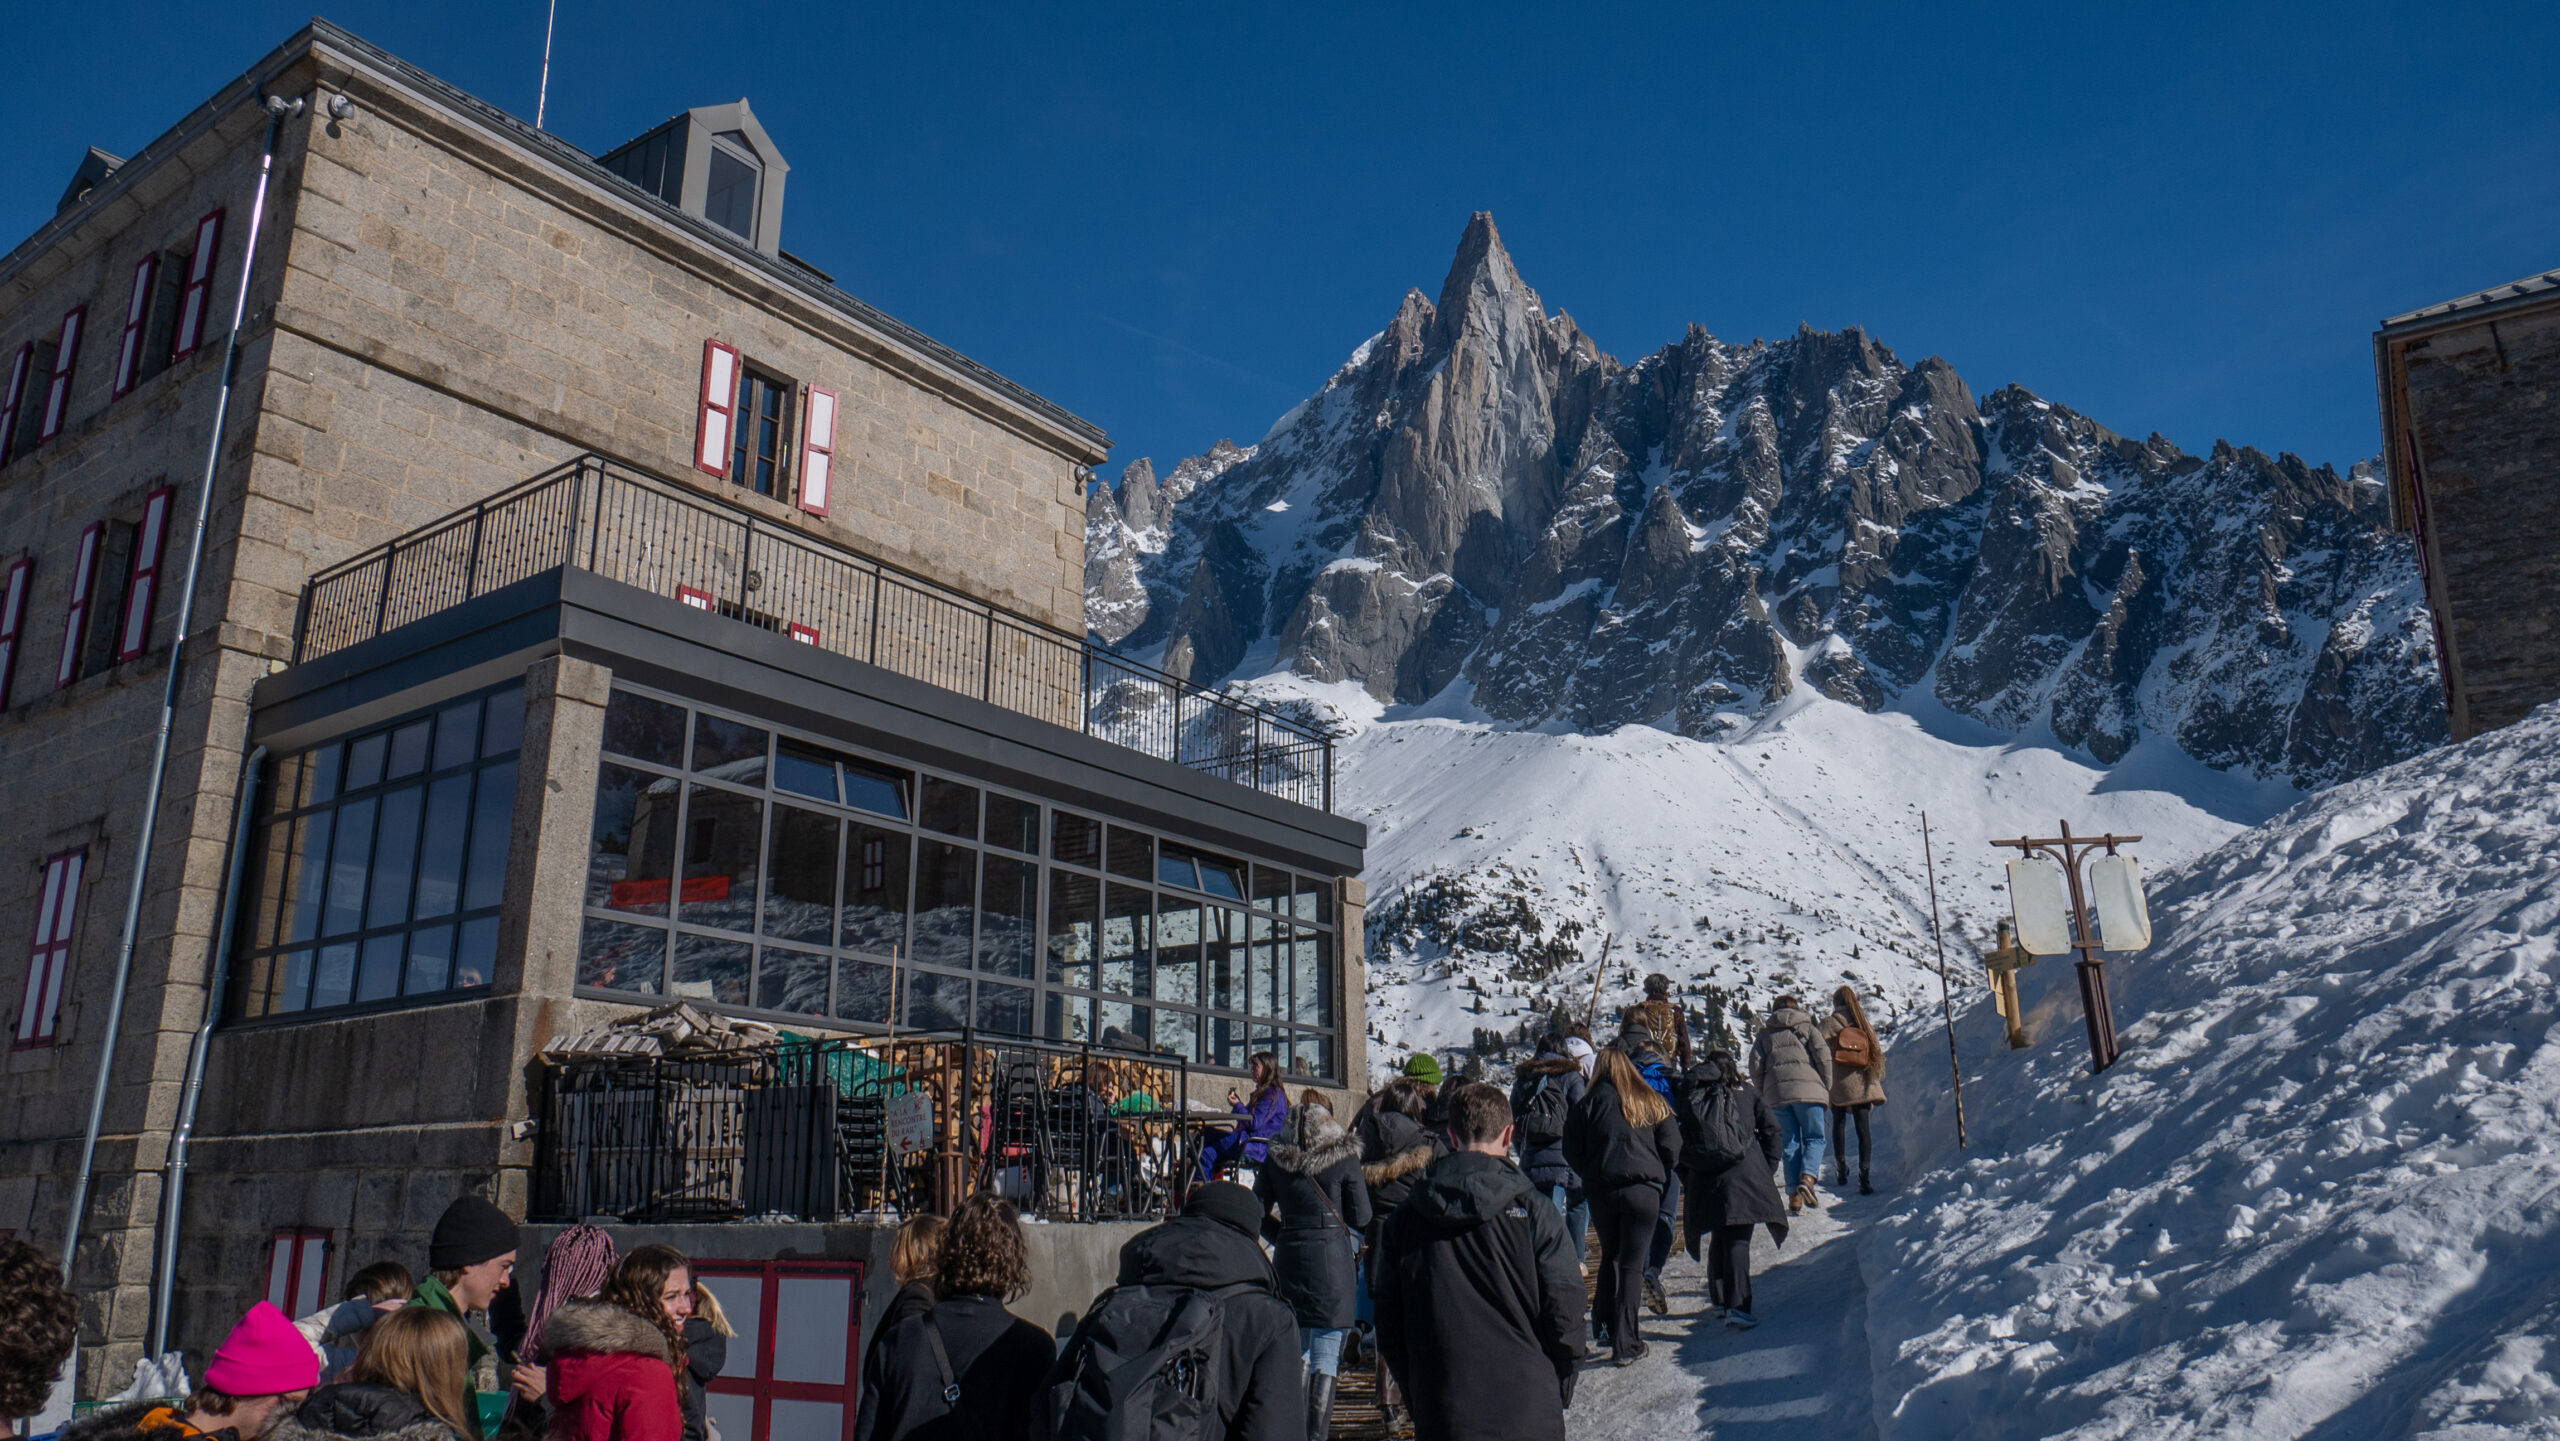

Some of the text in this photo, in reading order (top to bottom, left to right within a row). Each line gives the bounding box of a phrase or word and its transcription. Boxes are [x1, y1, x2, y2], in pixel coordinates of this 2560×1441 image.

[900, 1108, 907, 1116] LA
[891, 1113, 926, 1128] RENCONTRE
[891, 1128, 900, 1137] DU
